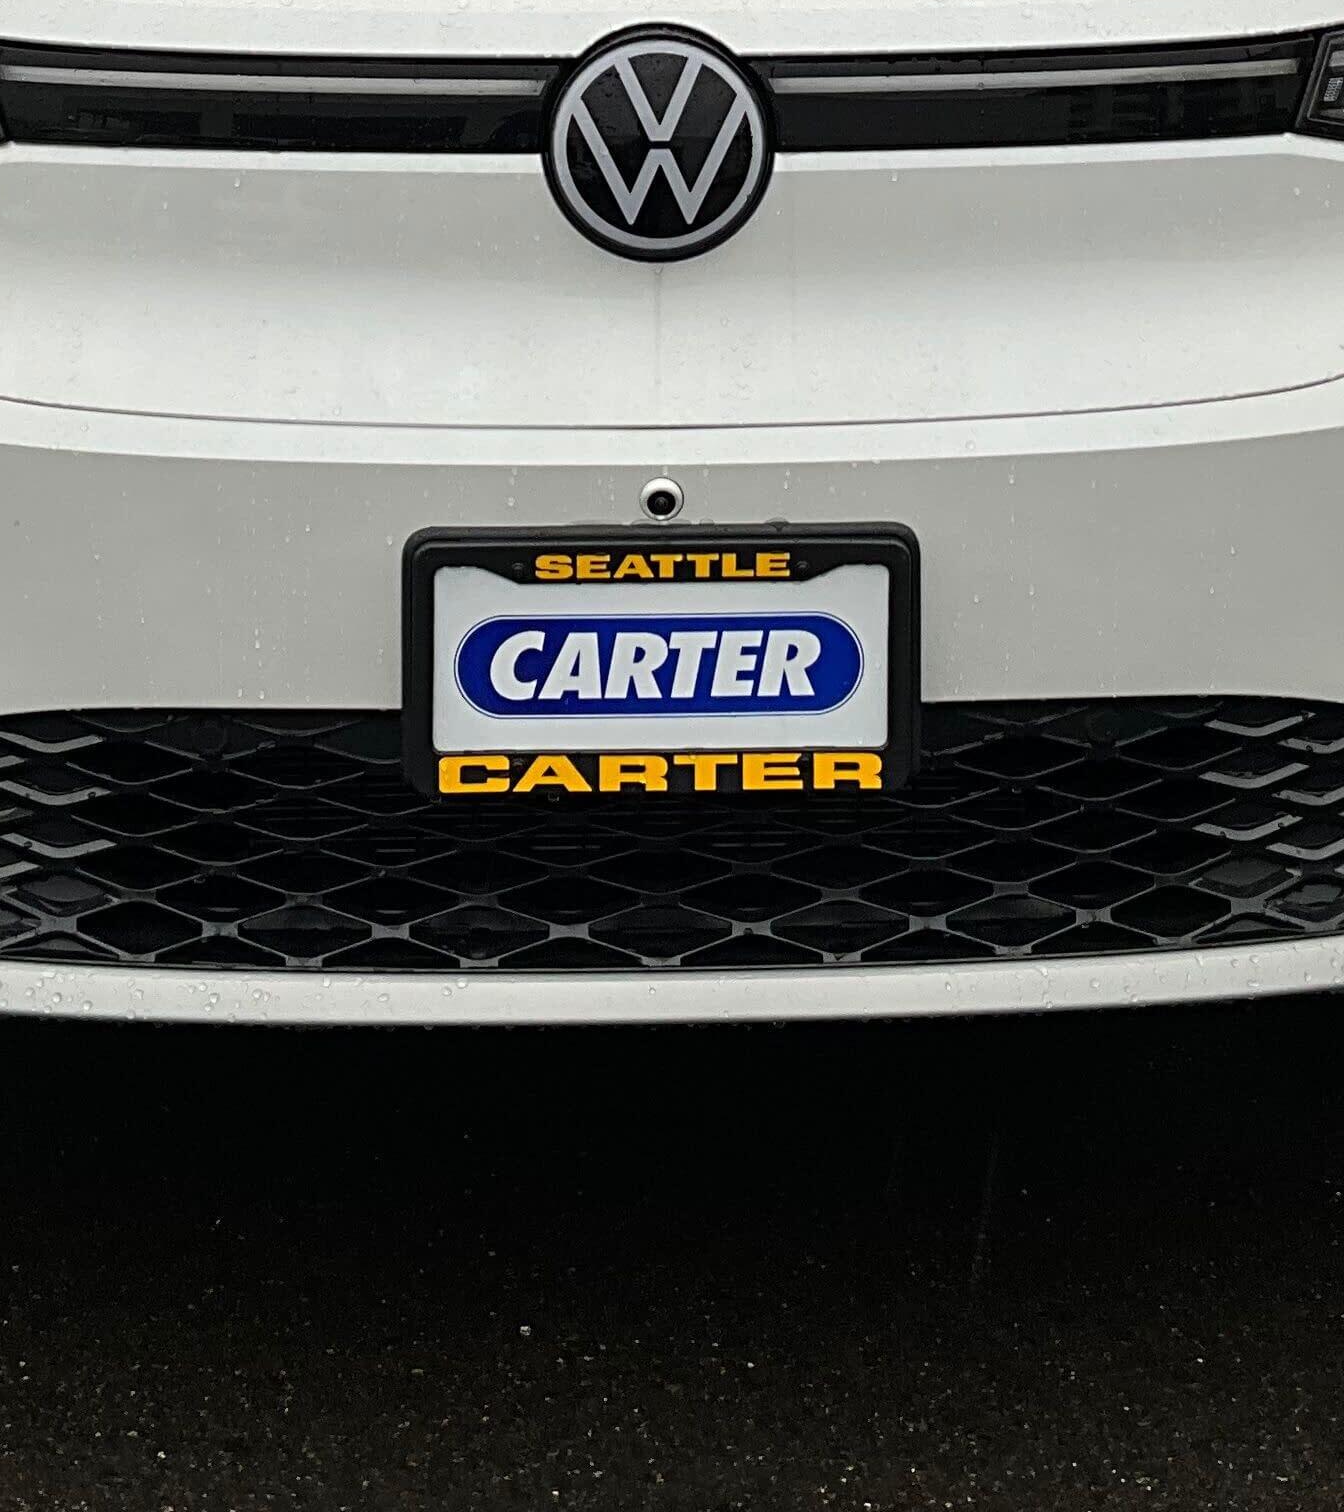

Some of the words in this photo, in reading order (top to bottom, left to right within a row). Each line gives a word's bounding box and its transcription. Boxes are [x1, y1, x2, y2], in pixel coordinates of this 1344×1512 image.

[554, 39, 763, 250] VW
[535, 552, 790, 580] SEATTLE
[489, 630, 822, 701] CARTER
[438, 752, 883, 794] CARTER
